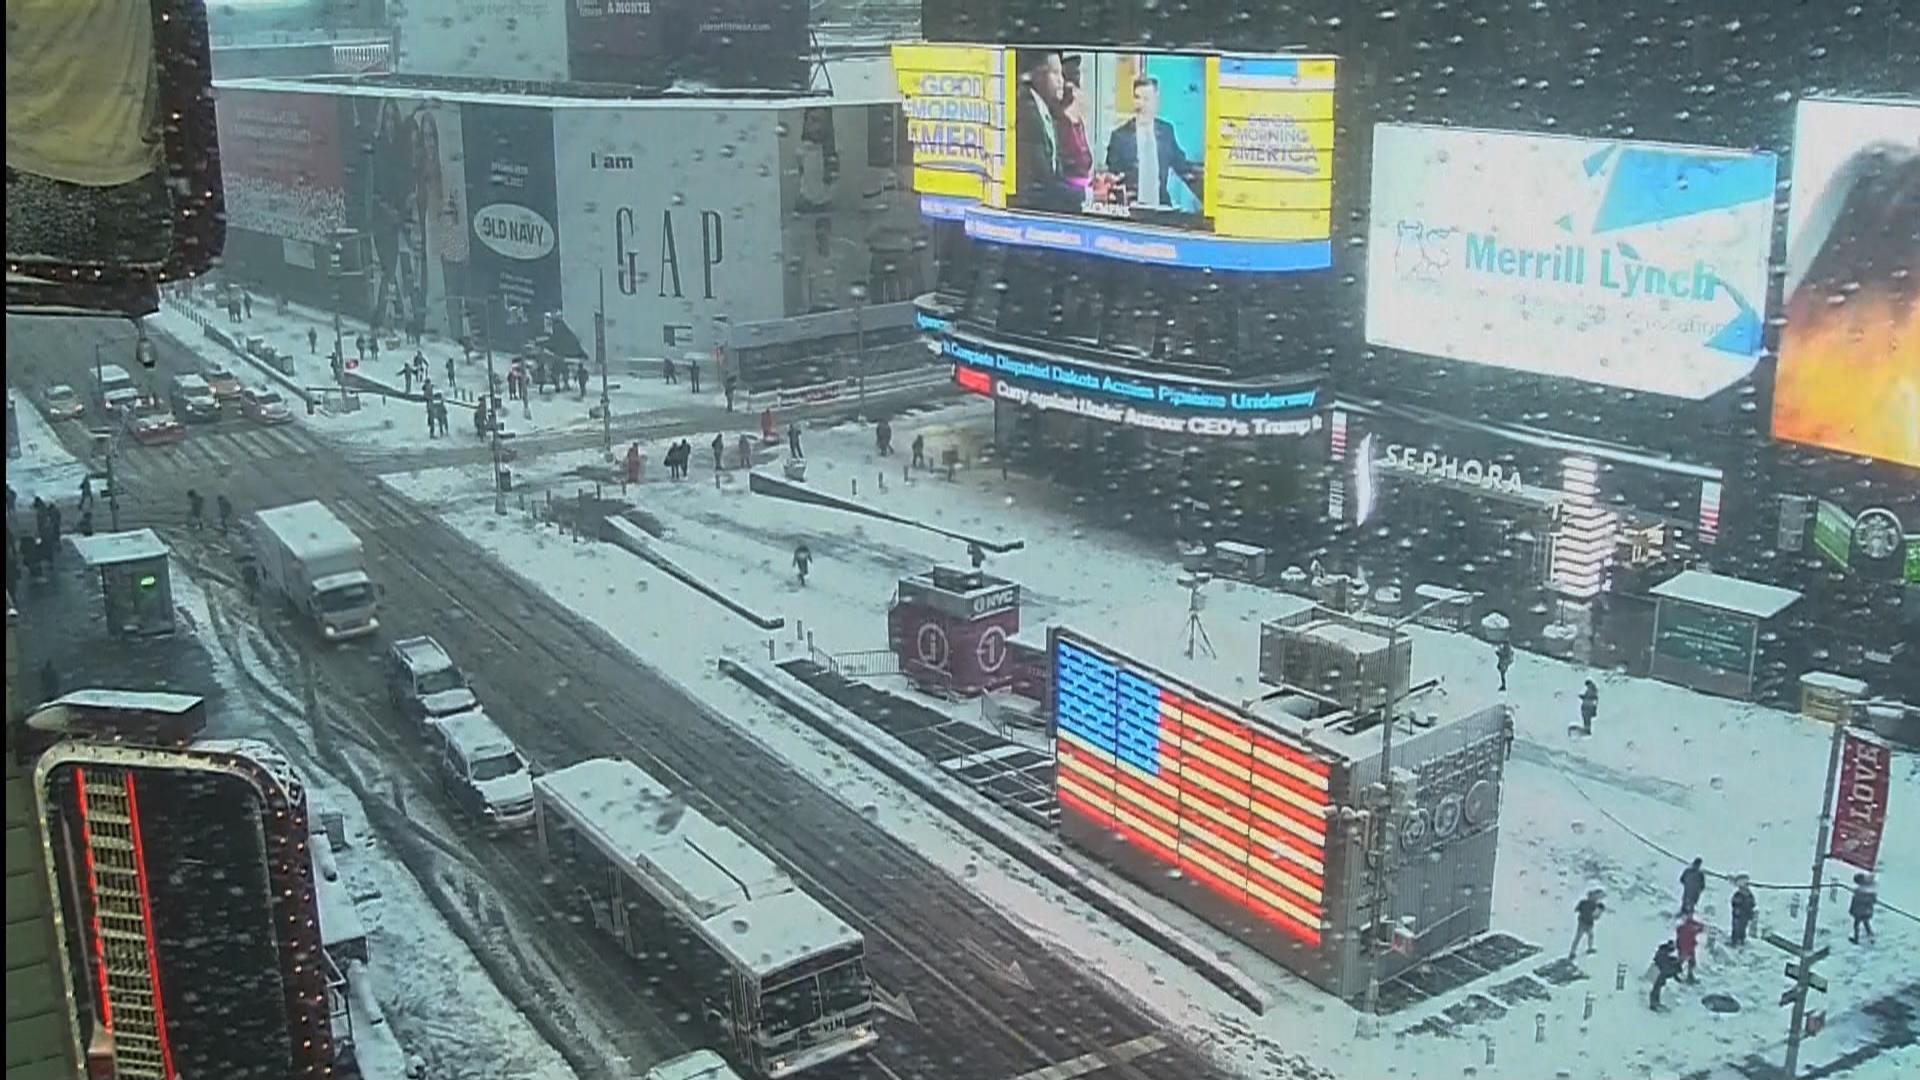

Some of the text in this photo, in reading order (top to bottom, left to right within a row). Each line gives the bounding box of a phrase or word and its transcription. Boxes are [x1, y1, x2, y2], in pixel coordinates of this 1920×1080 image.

[616, 2, 650, 14] MONTH
[603, 156, 634, 169] am
[482, 216, 544, 246] OLD NAVY
[616, 206, 723, 299] GAP
[1465, 231, 1719, 302] Merrill Lynch
[996, 354, 1050, 380] Disputed
[1052, 365, 1100, 390] Dakota
[1102, 376, 1154, 398] Access
[1187, 416, 1249, 436] CEO's
[1386, 444, 1522, 495] SEPHORA
